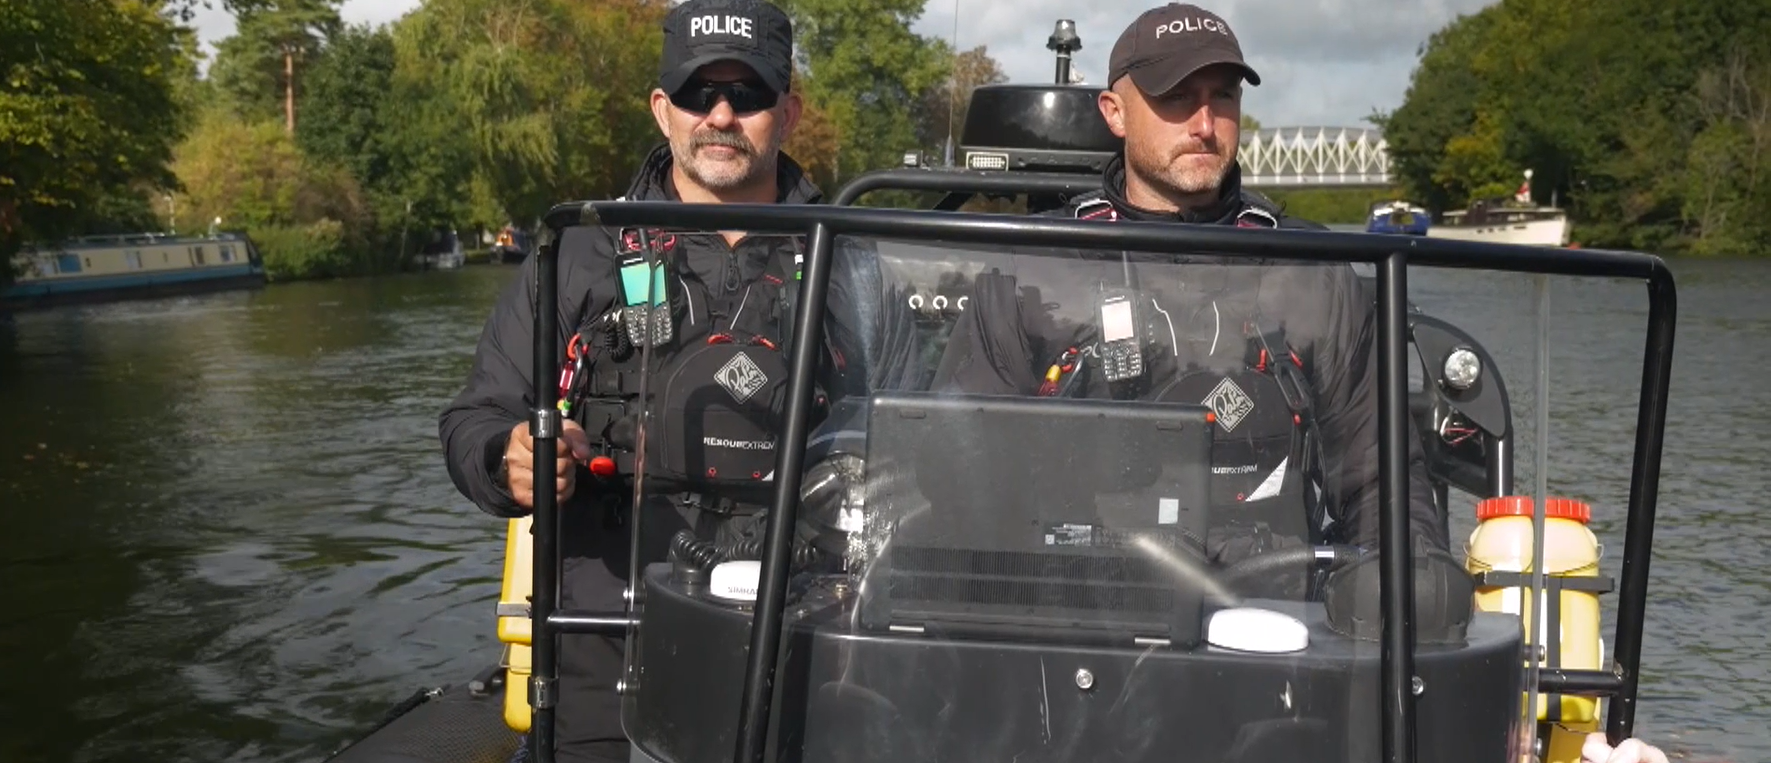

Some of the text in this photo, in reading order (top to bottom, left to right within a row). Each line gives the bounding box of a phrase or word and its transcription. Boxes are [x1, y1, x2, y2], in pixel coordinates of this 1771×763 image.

[690, 14, 753, 39] POLICE
[1155, 16, 1228, 39] POLICE
[727, 586, 759, 595] SIMRA
